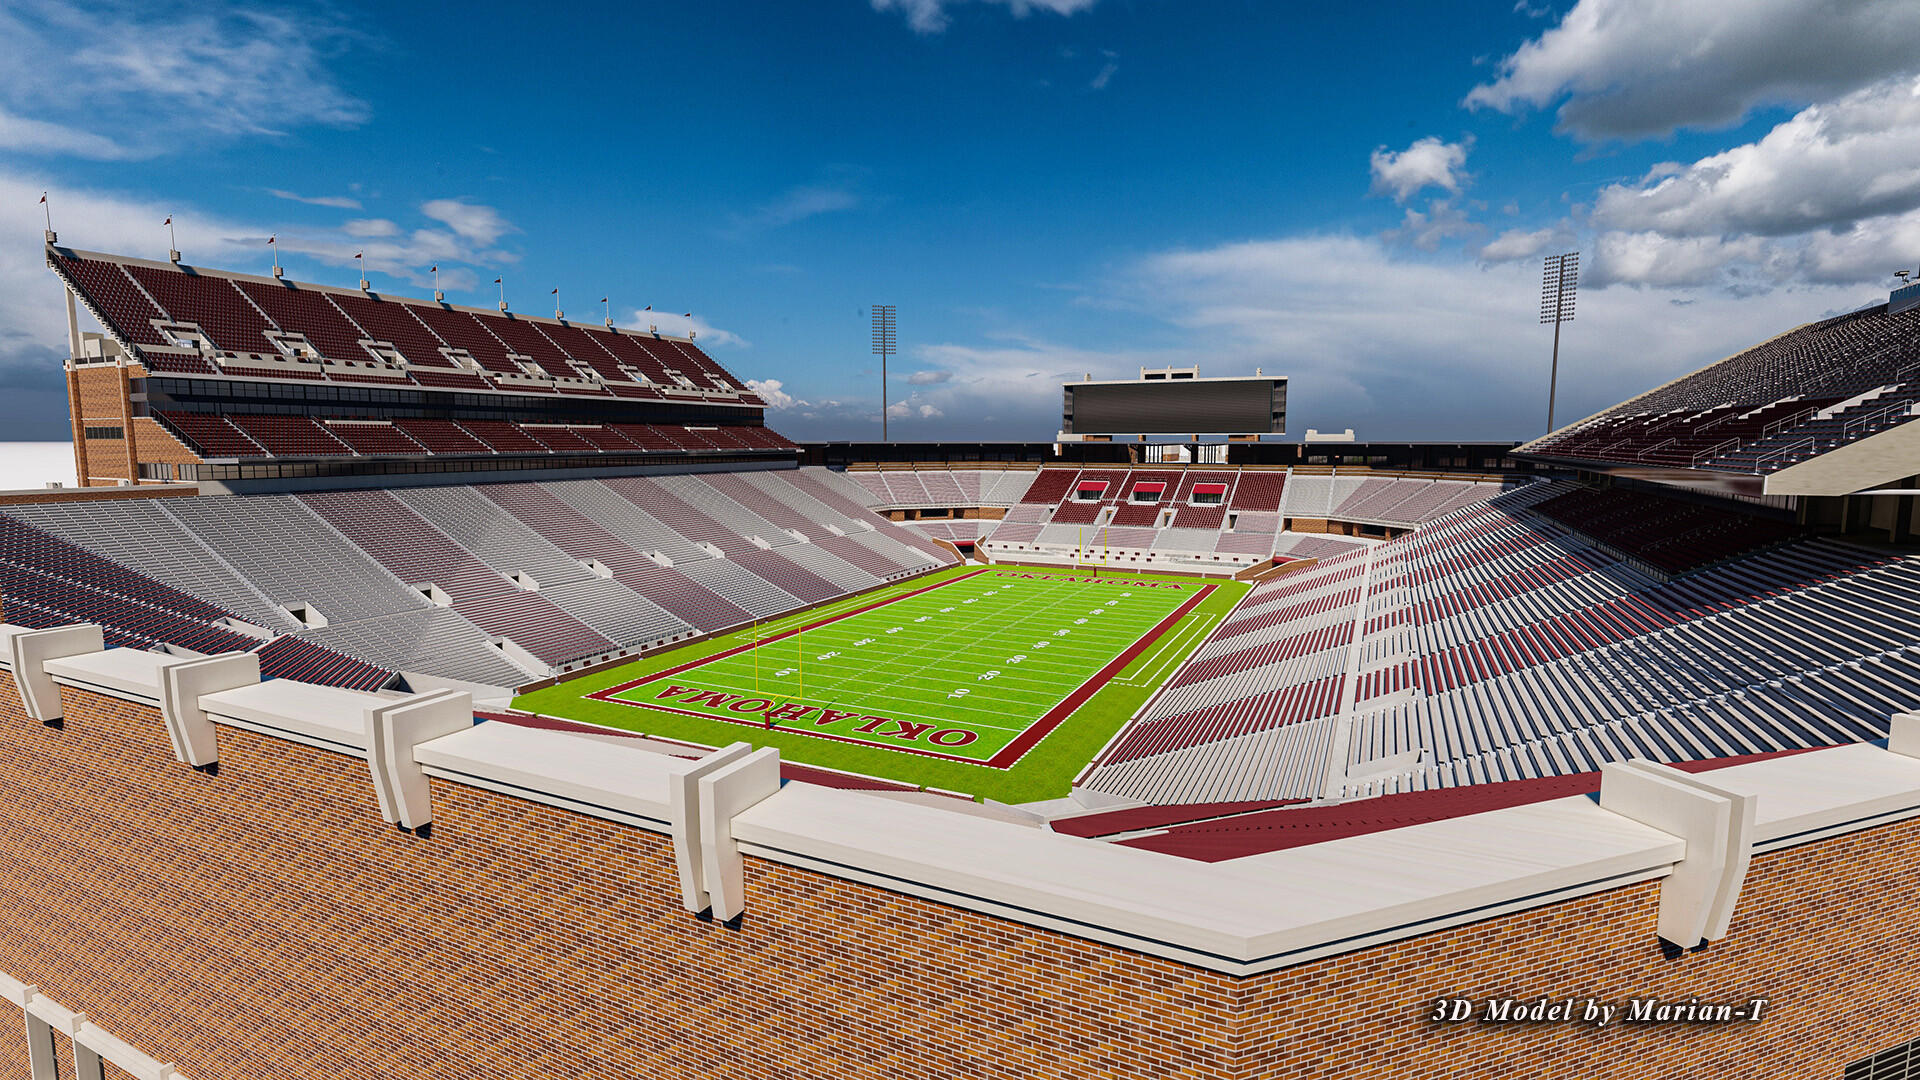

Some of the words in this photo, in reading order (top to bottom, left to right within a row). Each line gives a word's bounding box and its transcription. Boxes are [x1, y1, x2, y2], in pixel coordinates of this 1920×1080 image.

[977, 671, 1001, 681] 20
[946, 689, 970, 699] 10
[654, 685, 979, 747] OKLAHOMA
